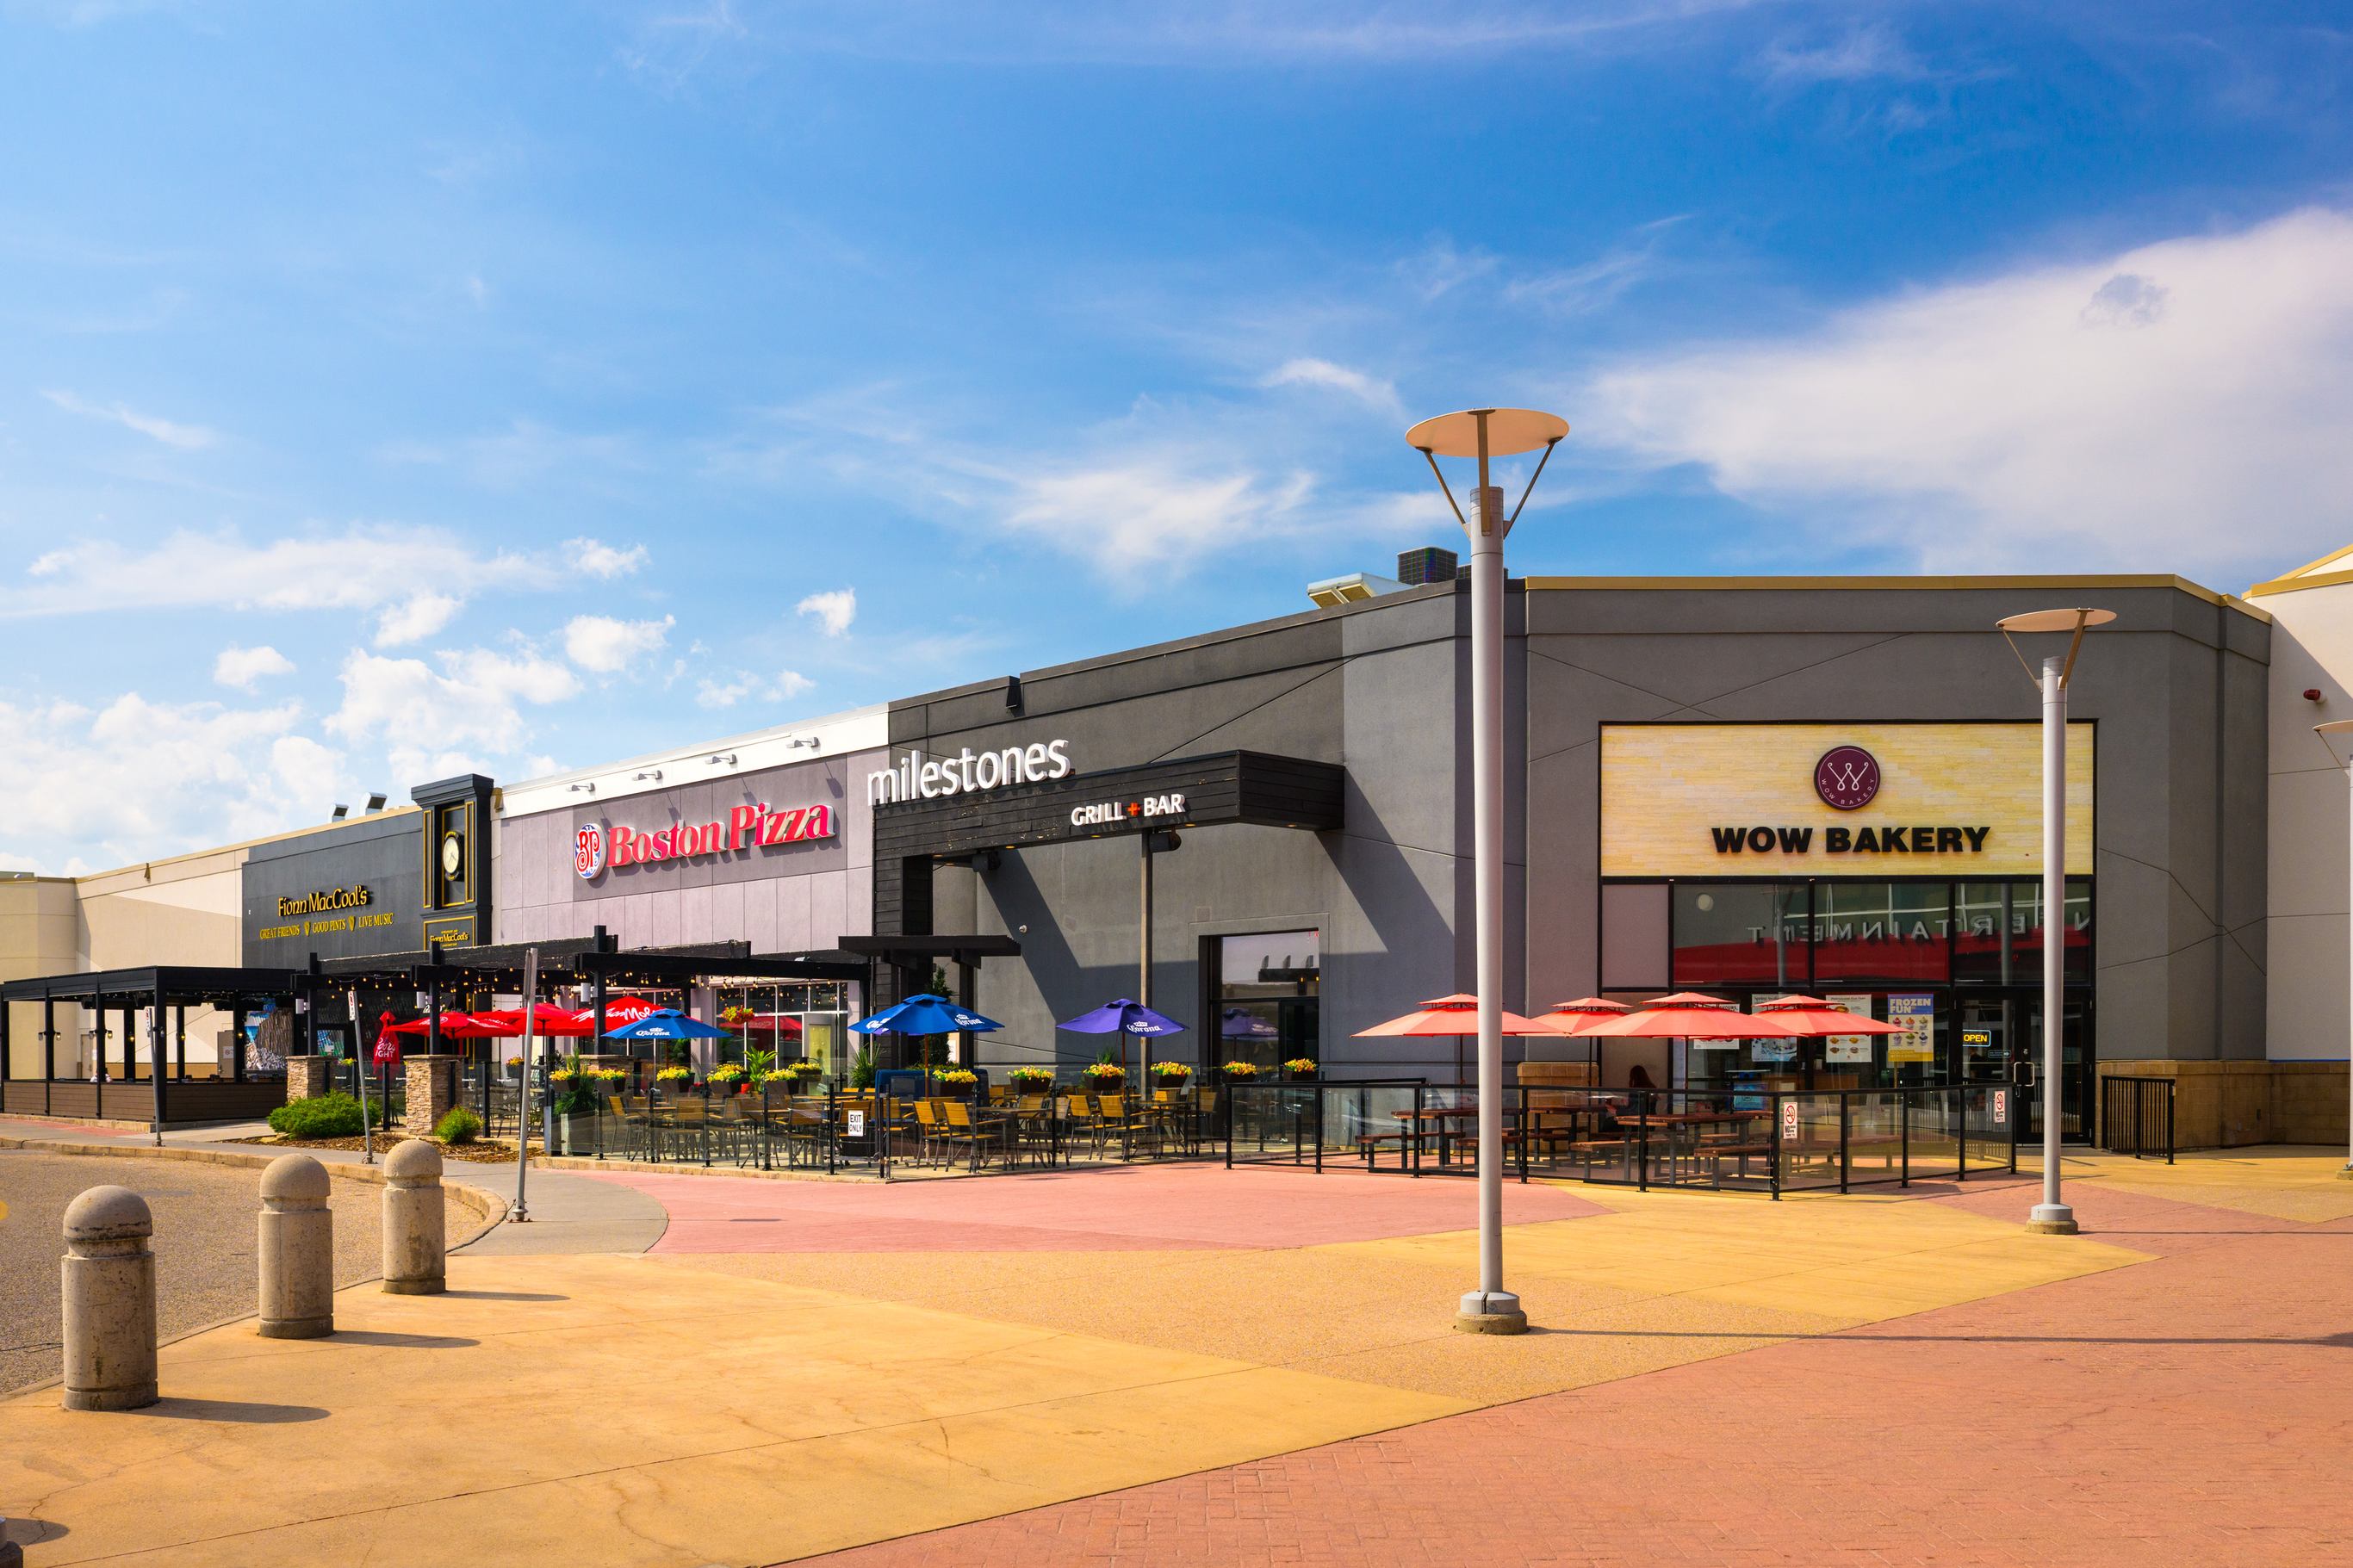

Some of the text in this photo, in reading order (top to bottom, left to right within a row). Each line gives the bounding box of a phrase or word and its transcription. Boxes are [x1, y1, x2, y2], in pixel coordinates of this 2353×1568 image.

[867, 739, 1071, 806] milestones
[1822, 778, 1875, 805] WOW BAKERY
[1071, 802, 1127, 827] GRILL
[1143, 793, 1186, 817] BAR
[606, 802, 835, 867] Boston Pizza
[1711, 826, 1991, 853] WOW BAKERY
[575, 828, 601, 874] BP
[308, 884, 369, 913] MacCool's
[260, 912, 394, 940] GREAT FRIENDS GOOD PINTS LIVE MUSIC
[954, 1017, 985, 1026] Corona
[1127, 1023, 1164, 1033] Corona
[1964, 1034, 1988, 1043] OPEN
[375, 1049, 394, 1058] IGHT
[849, 1124, 862, 1132] ONLY
[850, 1114, 862, 1123] EXIT
